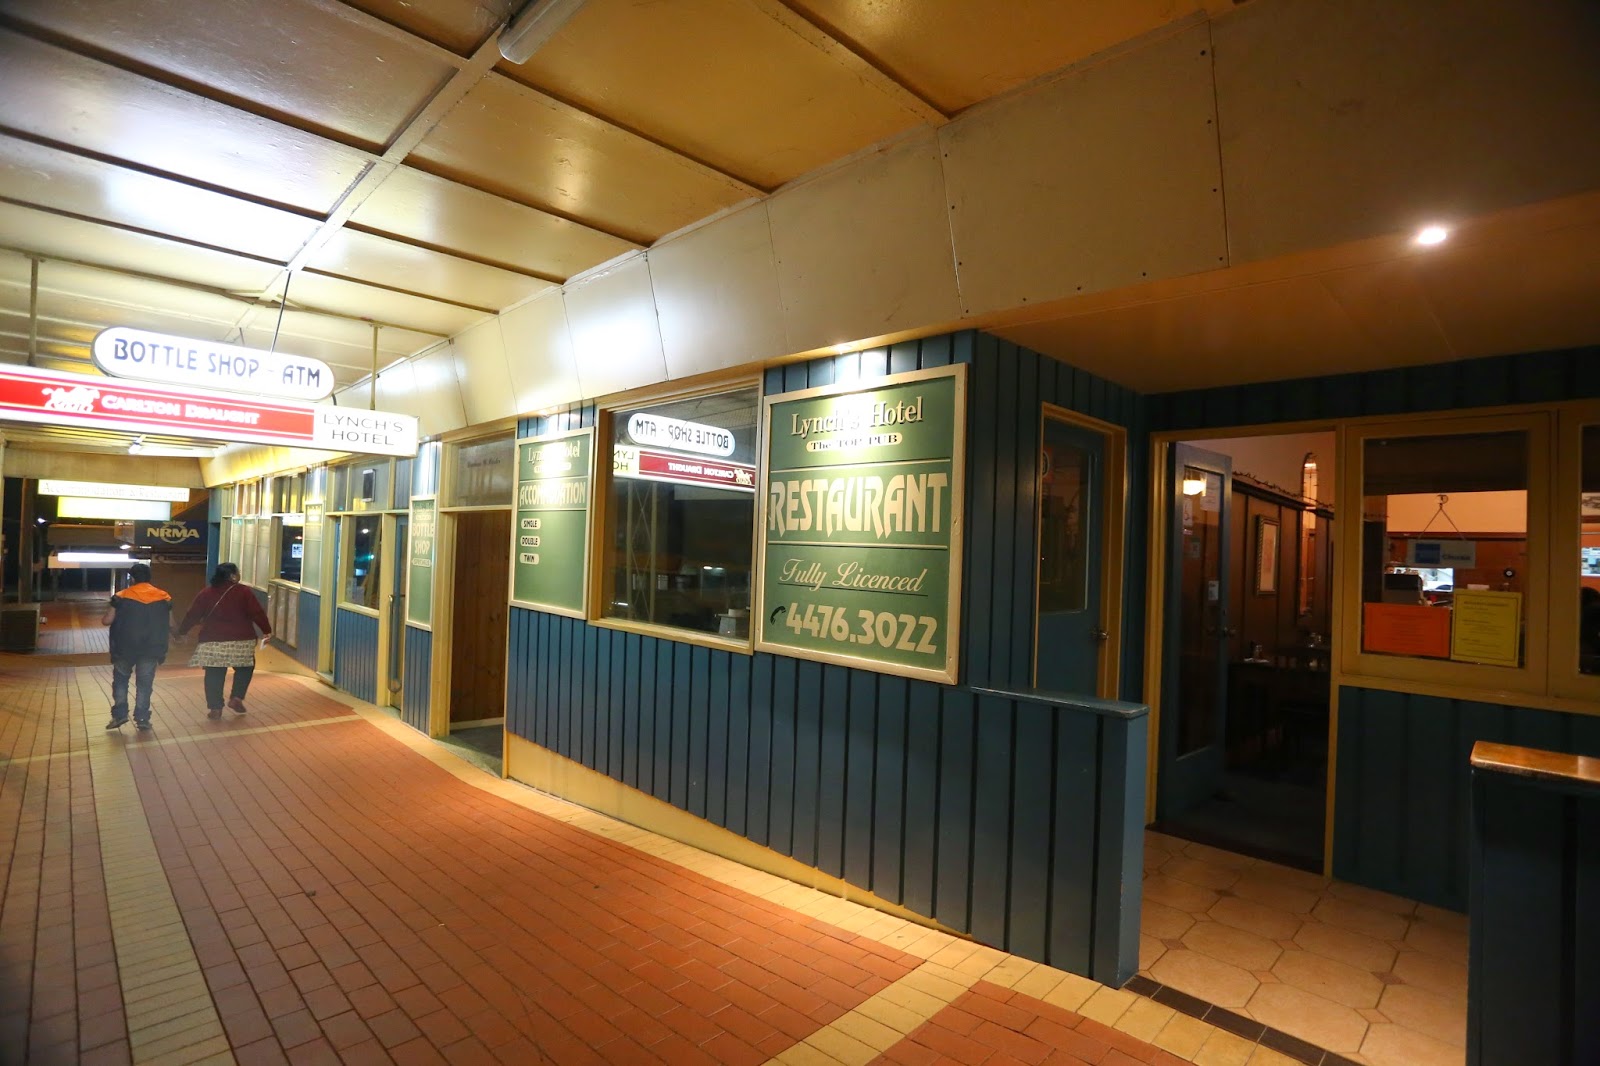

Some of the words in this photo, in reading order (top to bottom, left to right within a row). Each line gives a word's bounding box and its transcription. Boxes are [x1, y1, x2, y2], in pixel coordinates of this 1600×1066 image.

[114, 338, 198, 370] BOTTLE
[208, 352, 260, 378] SHOP
[282, 364, 321, 388] ATM
[101, 394, 181, 416] CARLTON
[185, 404, 260, 424] DRAUGHT
[870, 396, 924, 428] Hotel
[323, 414, 403, 432] LYNCH'S
[332, 429, 394, 446] HOTEL
[869, 434, 898, 445] PUB
[769, 472, 948, 540] RESTAURANT
[412, 522, 435, 537] BOTTLE
[523, 520, 538, 528] SINGLE
[147, 527, 200, 539] NRMA
[522, 537, 538, 546] DOUBLE
[414, 540, 431, 555] SHOP
[523, 554, 535, 562] TWIN
[779, 558, 826, 591] Fully
[832, 561, 928, 592] Licenced
[786, 602, 938, 655] 4476.3022
